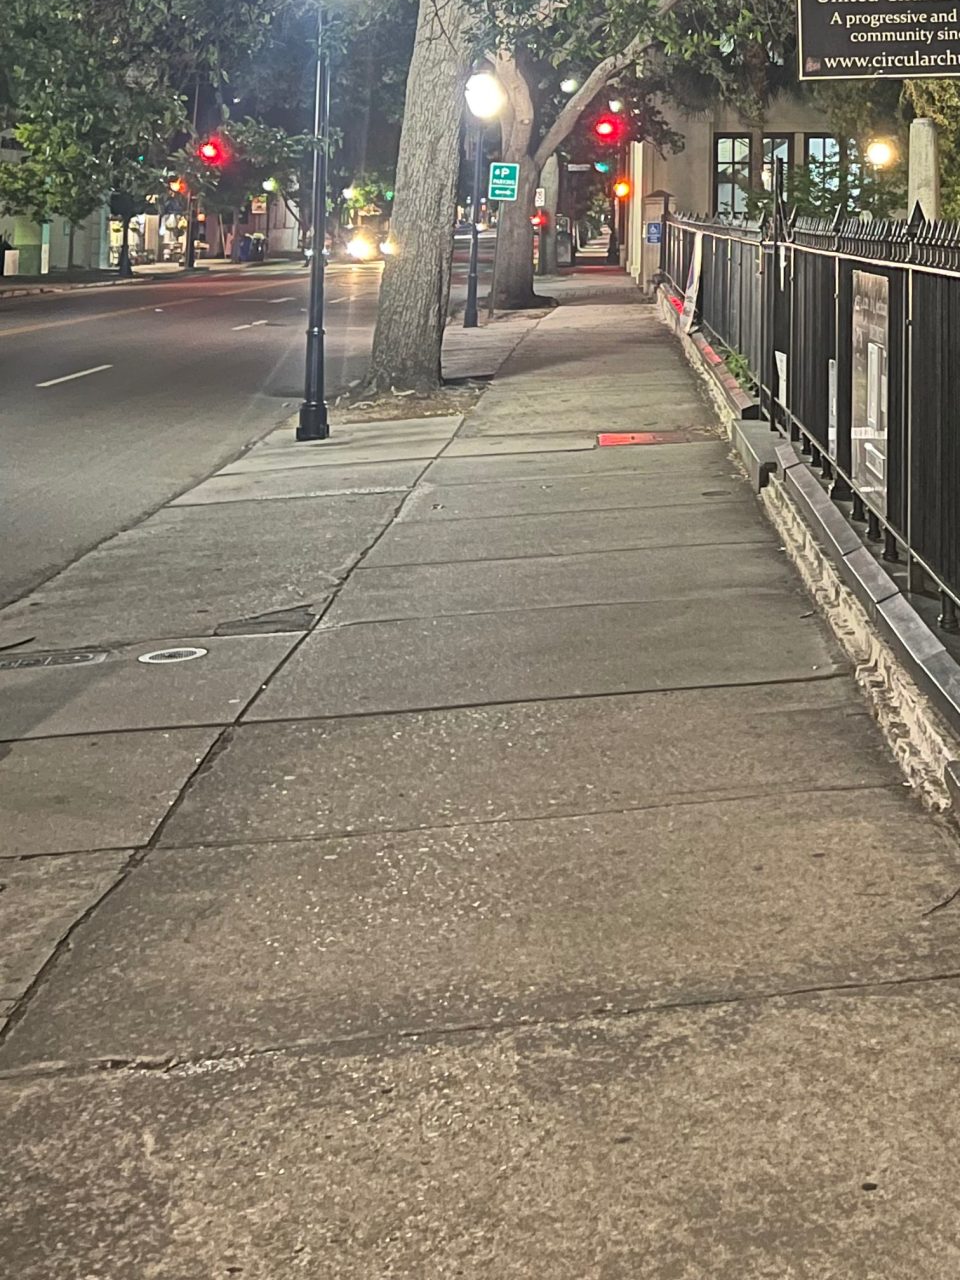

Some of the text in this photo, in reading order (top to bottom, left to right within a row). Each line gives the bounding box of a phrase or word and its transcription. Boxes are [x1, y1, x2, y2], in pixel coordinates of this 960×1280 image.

[831, 13, 842, 25] A
[846, 11, 927, 27] progressive
[930, 9, 957, 22] and
[850, 29, 934, 44] community
